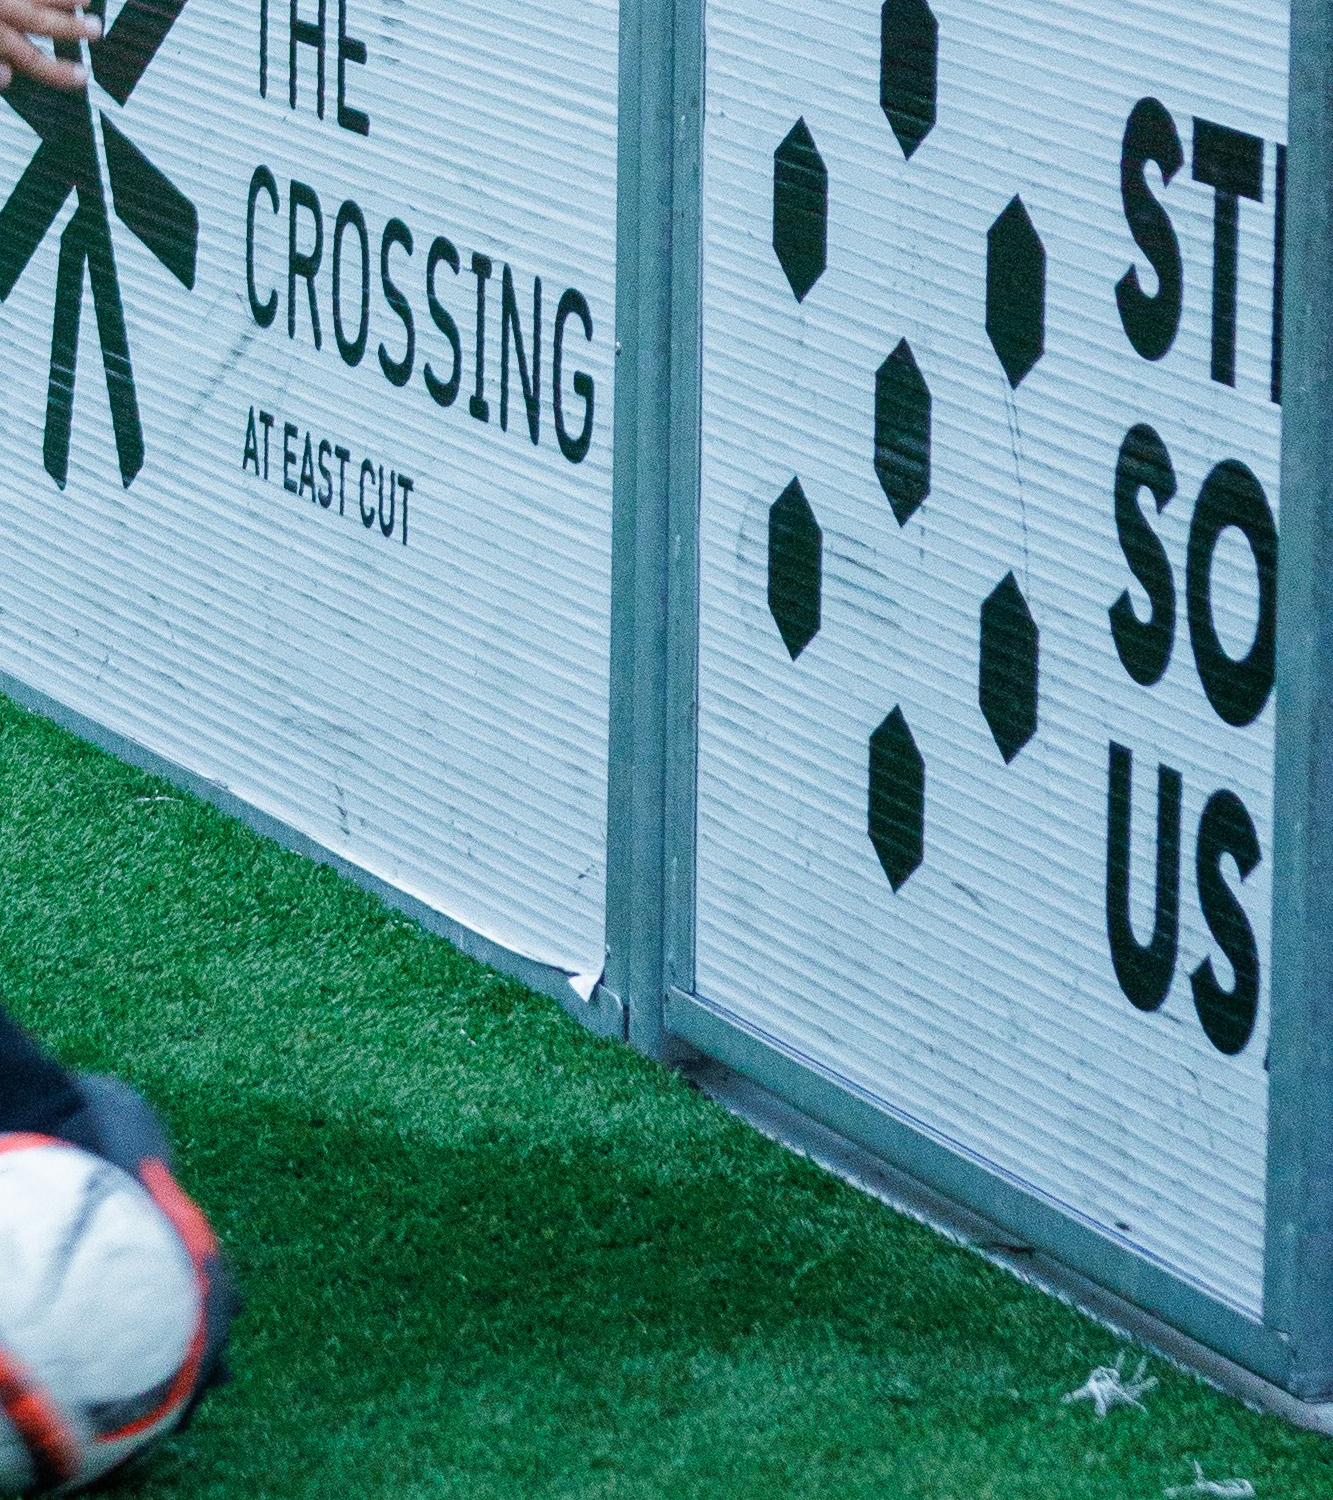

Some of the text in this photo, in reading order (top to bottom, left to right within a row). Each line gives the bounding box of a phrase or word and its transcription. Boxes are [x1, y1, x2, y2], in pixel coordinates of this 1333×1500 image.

[245, 164, 595, 466] CROSSING
[1114, 96, 1288, 403] ST
[242, 405, 415, 547] AT EAST CUT
